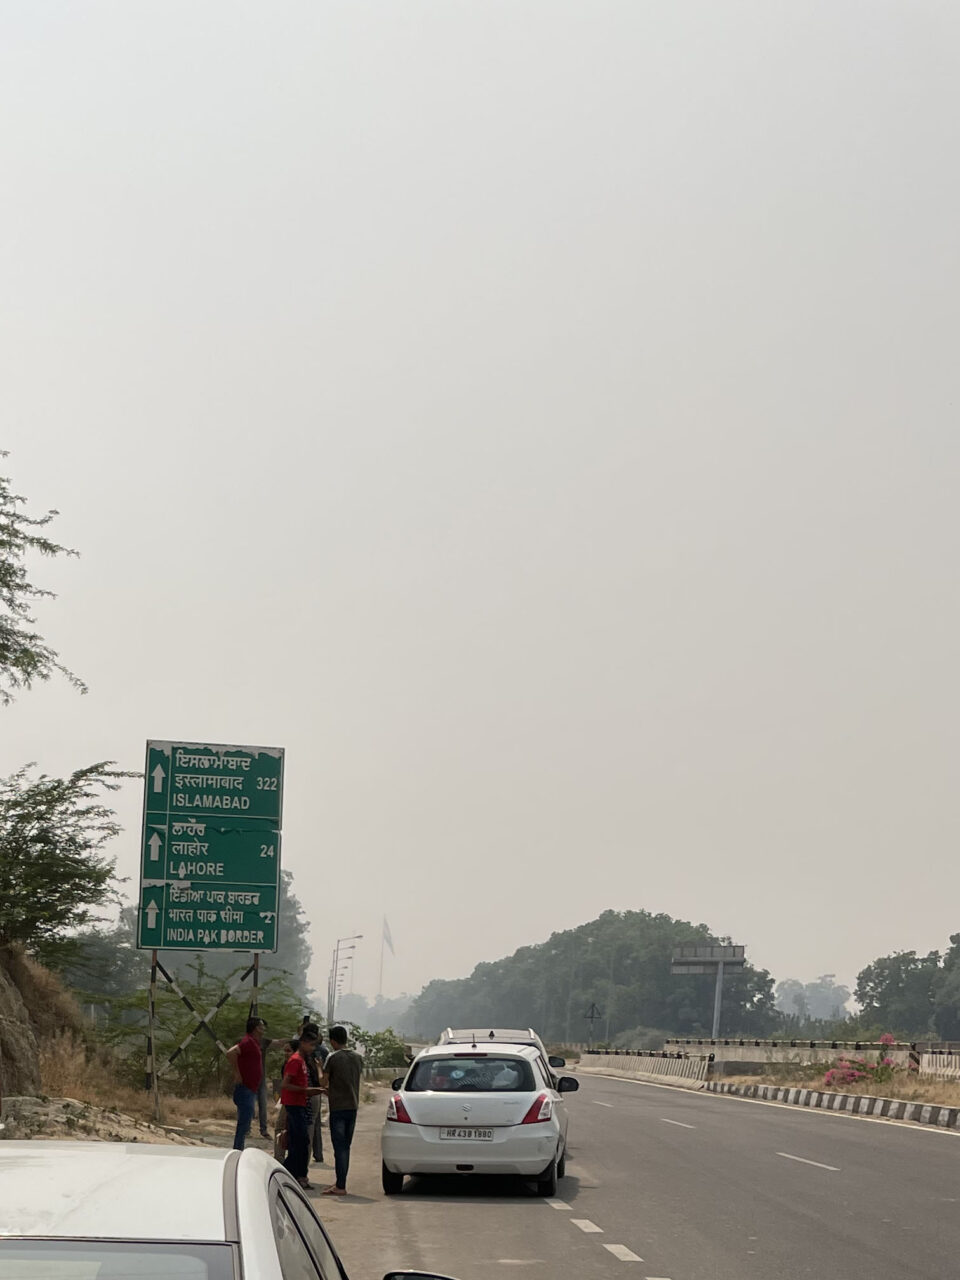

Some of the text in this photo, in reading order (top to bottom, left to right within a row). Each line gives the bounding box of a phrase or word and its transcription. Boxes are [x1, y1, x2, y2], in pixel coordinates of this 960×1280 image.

[174, 773, 244, 789] इस्लामाबाद
[256, 777, 278, 790] 322
[173, 793, 250, 809] ISLAMABAD
[171, 838, 209, 856] लाहोर
[260, 845, 274, 858] 24
[170, 861, 224, 876] LAHORE
[168, 905, 243, 923] भारत पाक सीमा
[264, 911, 272, 923] 2
[167, 928, 264, 944] INDIA PAK BORDER
